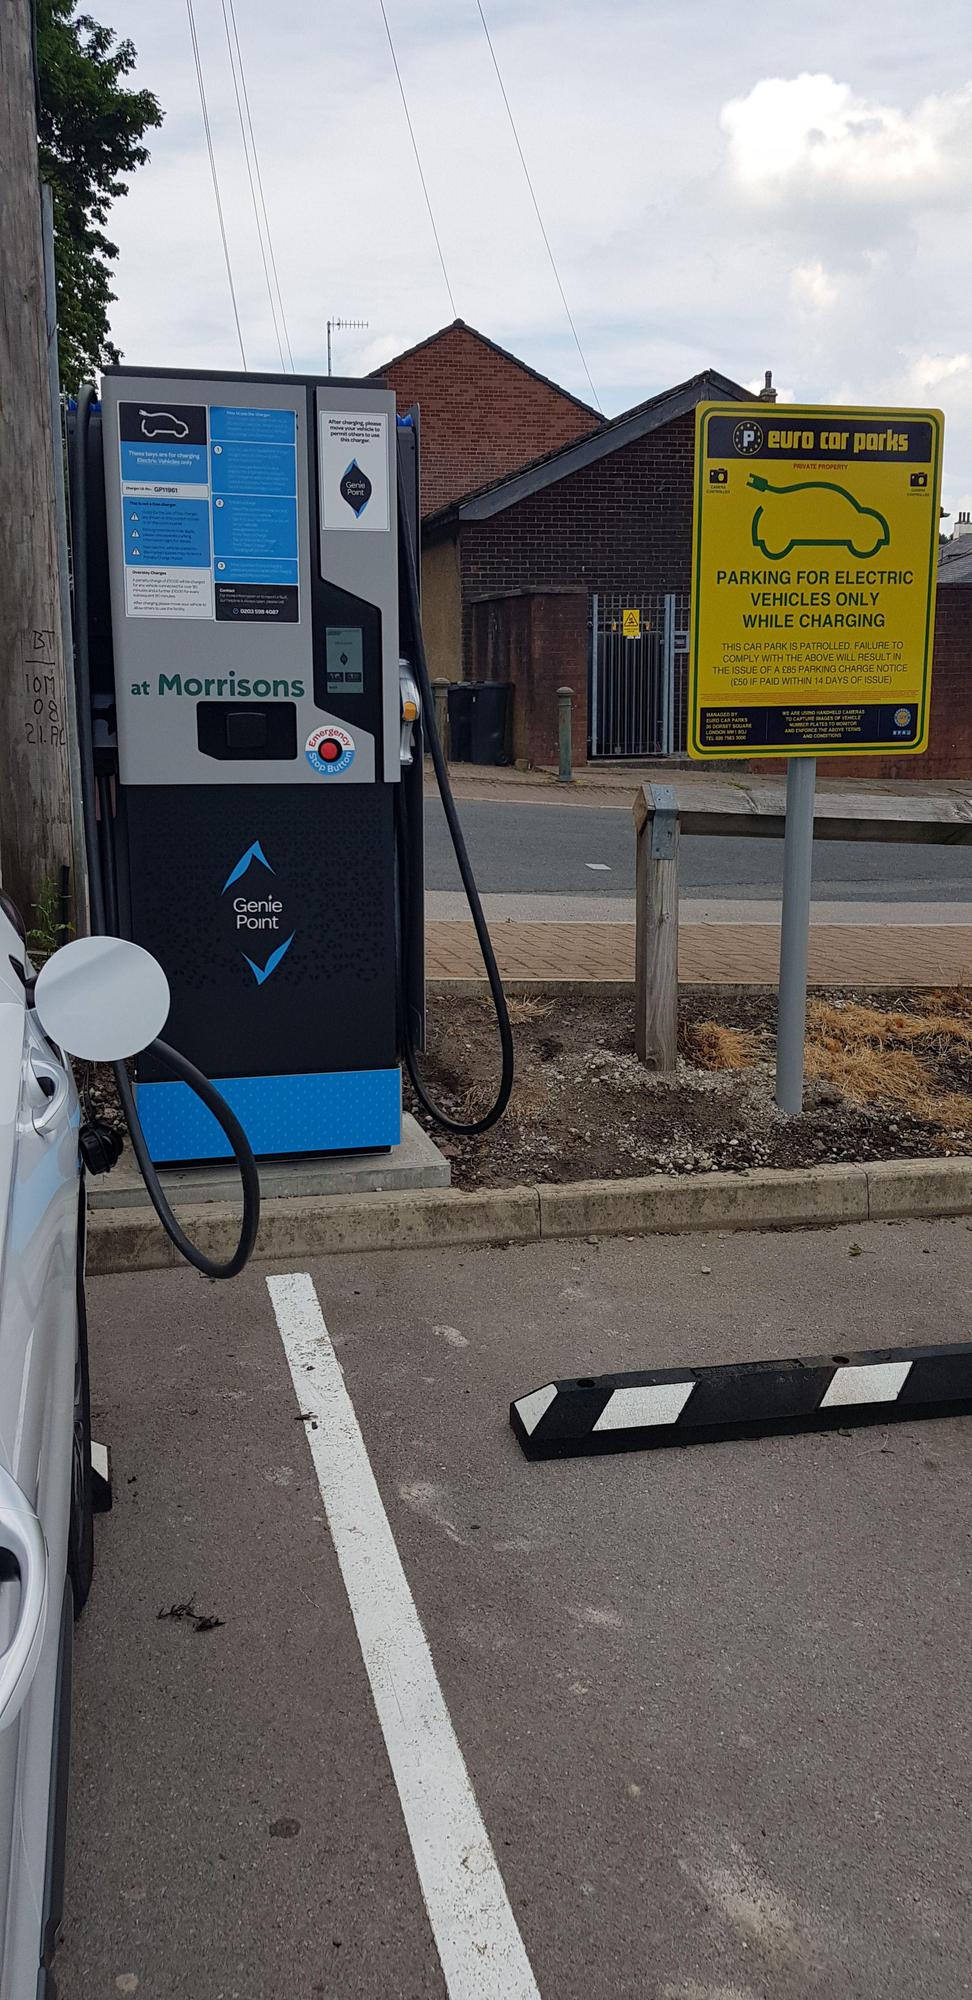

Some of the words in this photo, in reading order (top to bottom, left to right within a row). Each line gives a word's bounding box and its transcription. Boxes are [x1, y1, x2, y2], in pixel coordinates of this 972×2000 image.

[743, 430, 755, 447] P
[768, 430, 815, 449] euro
[820, 431, 850, 450] car
[854, 429, 909, 454] parks
[818, 463, 849, 471] PROPERTY
[346, 480, 366, 489] Genie
[717, 570, 791, 585] PARKING
[797, 570, 830, 585] FOR
[835, 570, 914, 585] ELECTRIC
[751, 592, 831, 607] VEHICLES
[836, 591, 880, 606] ONLY
[743, 614, 794, 628] WHILE
[799, 613, 886, 628] CHARGING
[32, 629, 55, 650] BT
[722, 642, 742, 651] THIS
[744, 642, 762, 651] CAR
[764, 642, 788, 651] PARK
[790, 642, 798, 651] IS
[855, 641, 891, 650] FAILURE
[892, 641, 904, 650] TO
[723, 654, 760, 663] COMPLY
[762, 654, 784, 663] WITH
[786, 654, 803, 663] THE
[805, 653, 834, 662] ABOVE
[837, 653, 856, 662] WILL
[858, 653, 892, 662] RESULT
[893, 652, 902, 661] IN
[713, 666, 730, 675] THE
[732, 666, 758, 675] ISSUE
[760, 665, 772, 675] OF
[774, 666, 780, 674] A
[782, 665, 797, 674] £85
[799, 665, 837, 674] PARKING
[838, 664, 875, 673] CHARGE
[877, 664, 908, 673] NOTICE
[131, 681, 150, 696] at
[158, 670, 305, 697] Morrisons
[731, 677, 748, 688] (£50
[750, 677, 759, 686] IF
[760, 677, 780, 686] PAID
[782, 676, 813, 686] WITHIN
[815, 676, 824, 685] 14
[825, 676, 849, 685] DAYS
[851, 675, 863, 684] OF
[864, 675, 893, 685] ISSUE)
[308, 728, 351, 748] Emergency
[309, 752, 326, 772] Stop
[327, 751, 353, 773] Button
[233, 894, 283, 913] Genie
[237, 914, 280, 930] Point
